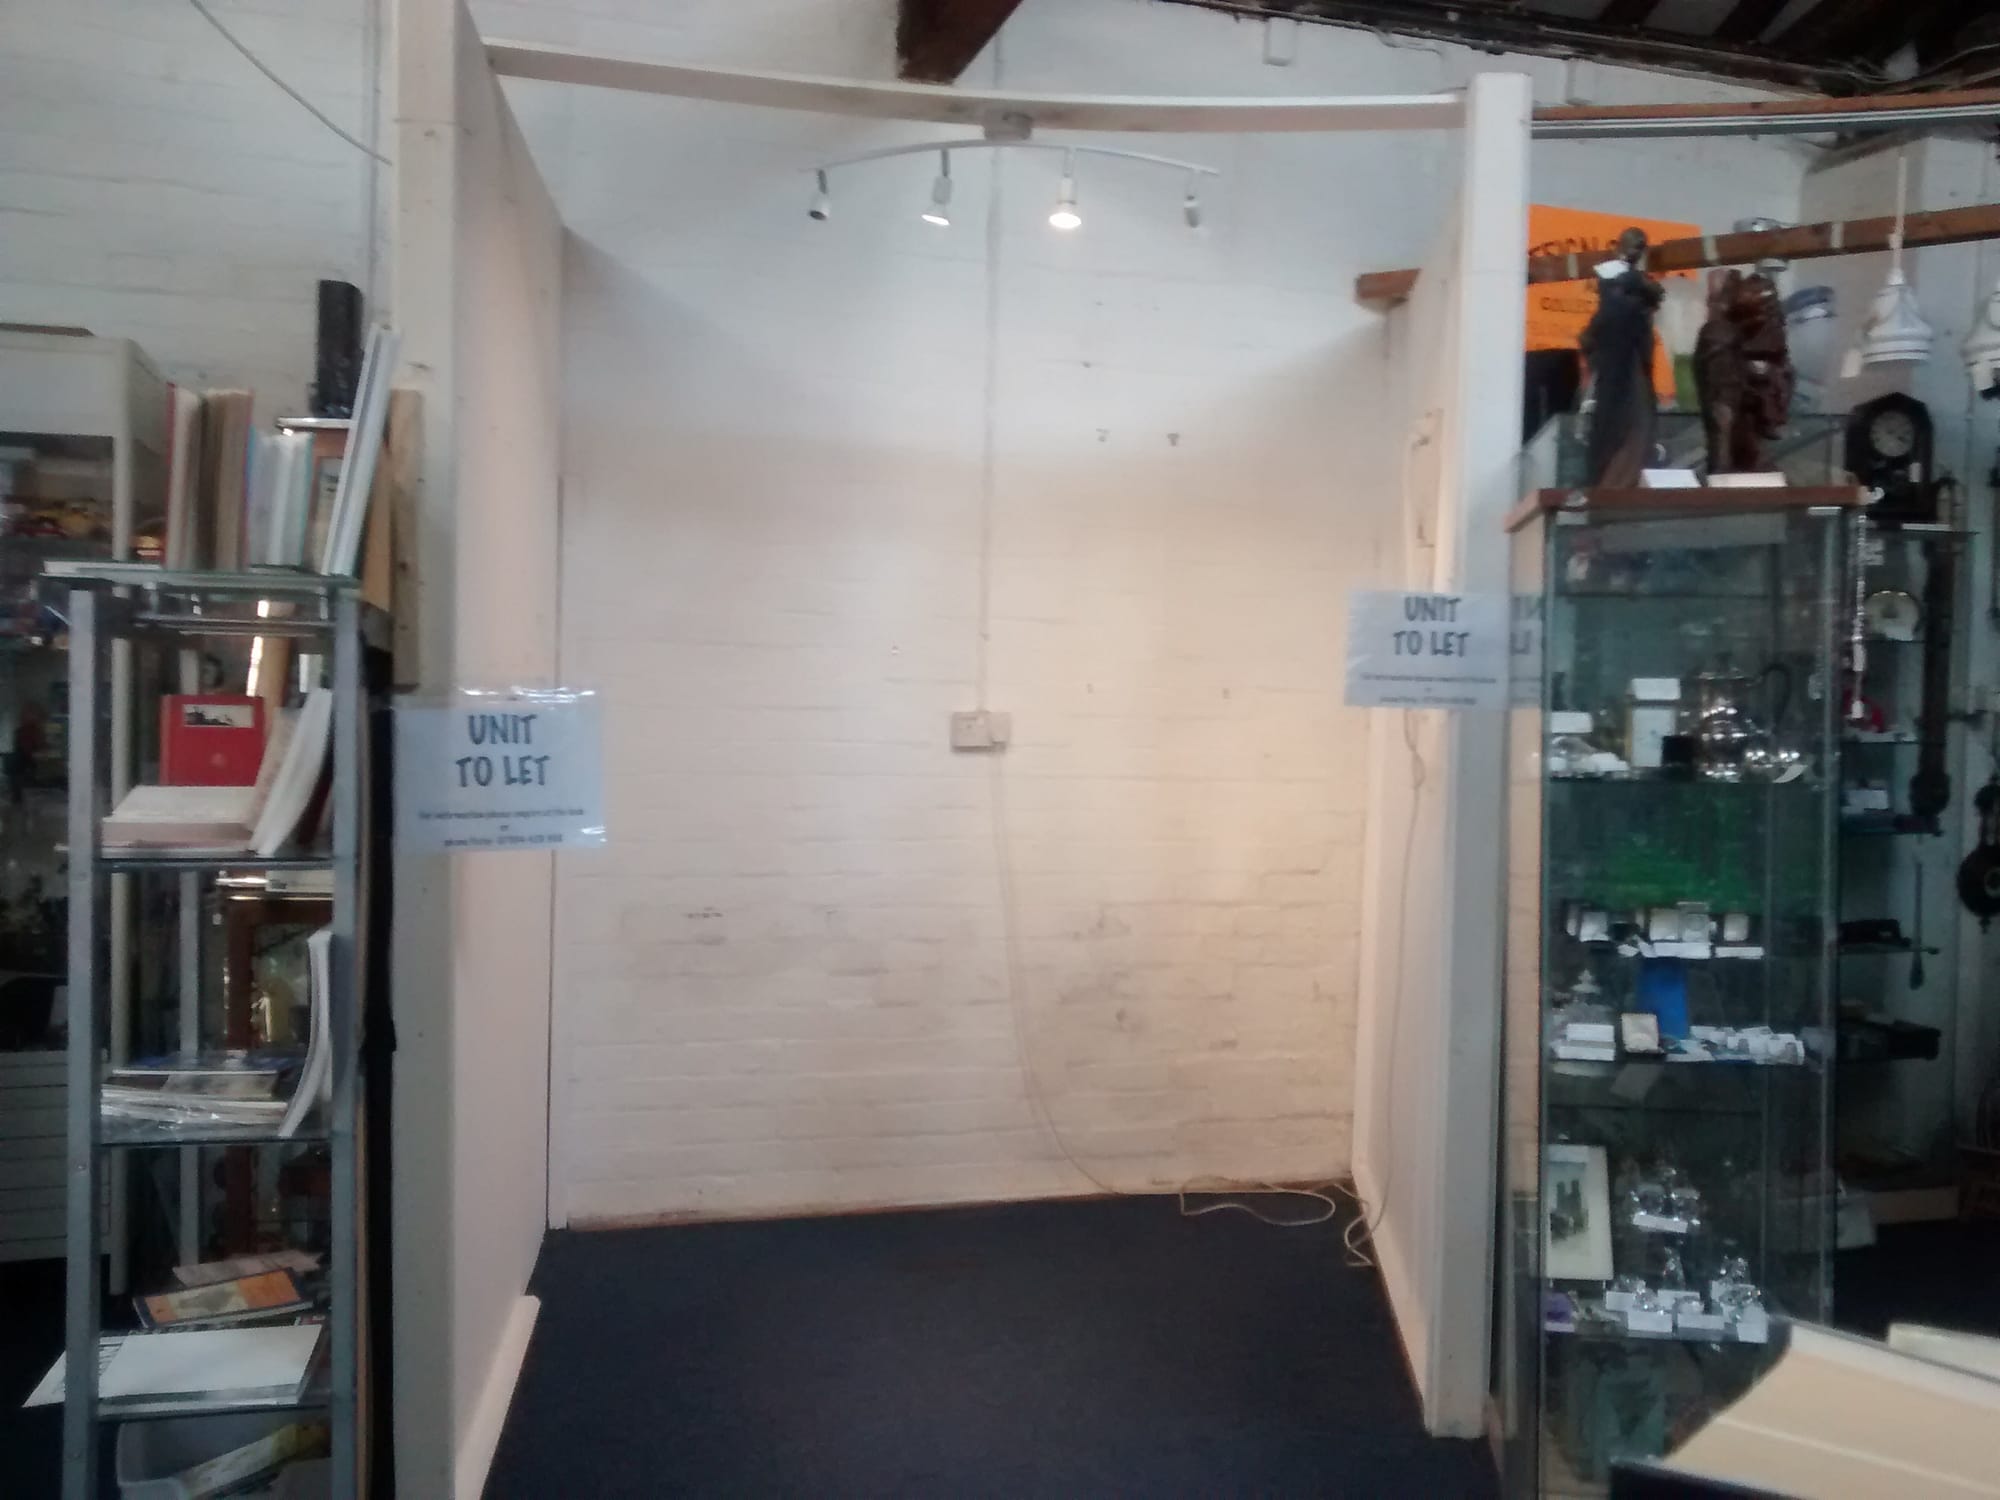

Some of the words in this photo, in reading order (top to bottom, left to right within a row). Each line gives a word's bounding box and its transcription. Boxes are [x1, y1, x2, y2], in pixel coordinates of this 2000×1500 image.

[1404, 596, 1461, 622] UNIT
[1393, 630, 1423, 656] TO
[1430, 631, 1470, 657] LET
[468, 714, 537, 745] UNIT
[456, 756, 493, 787] TO
[503, 755, 550, 785] LET
